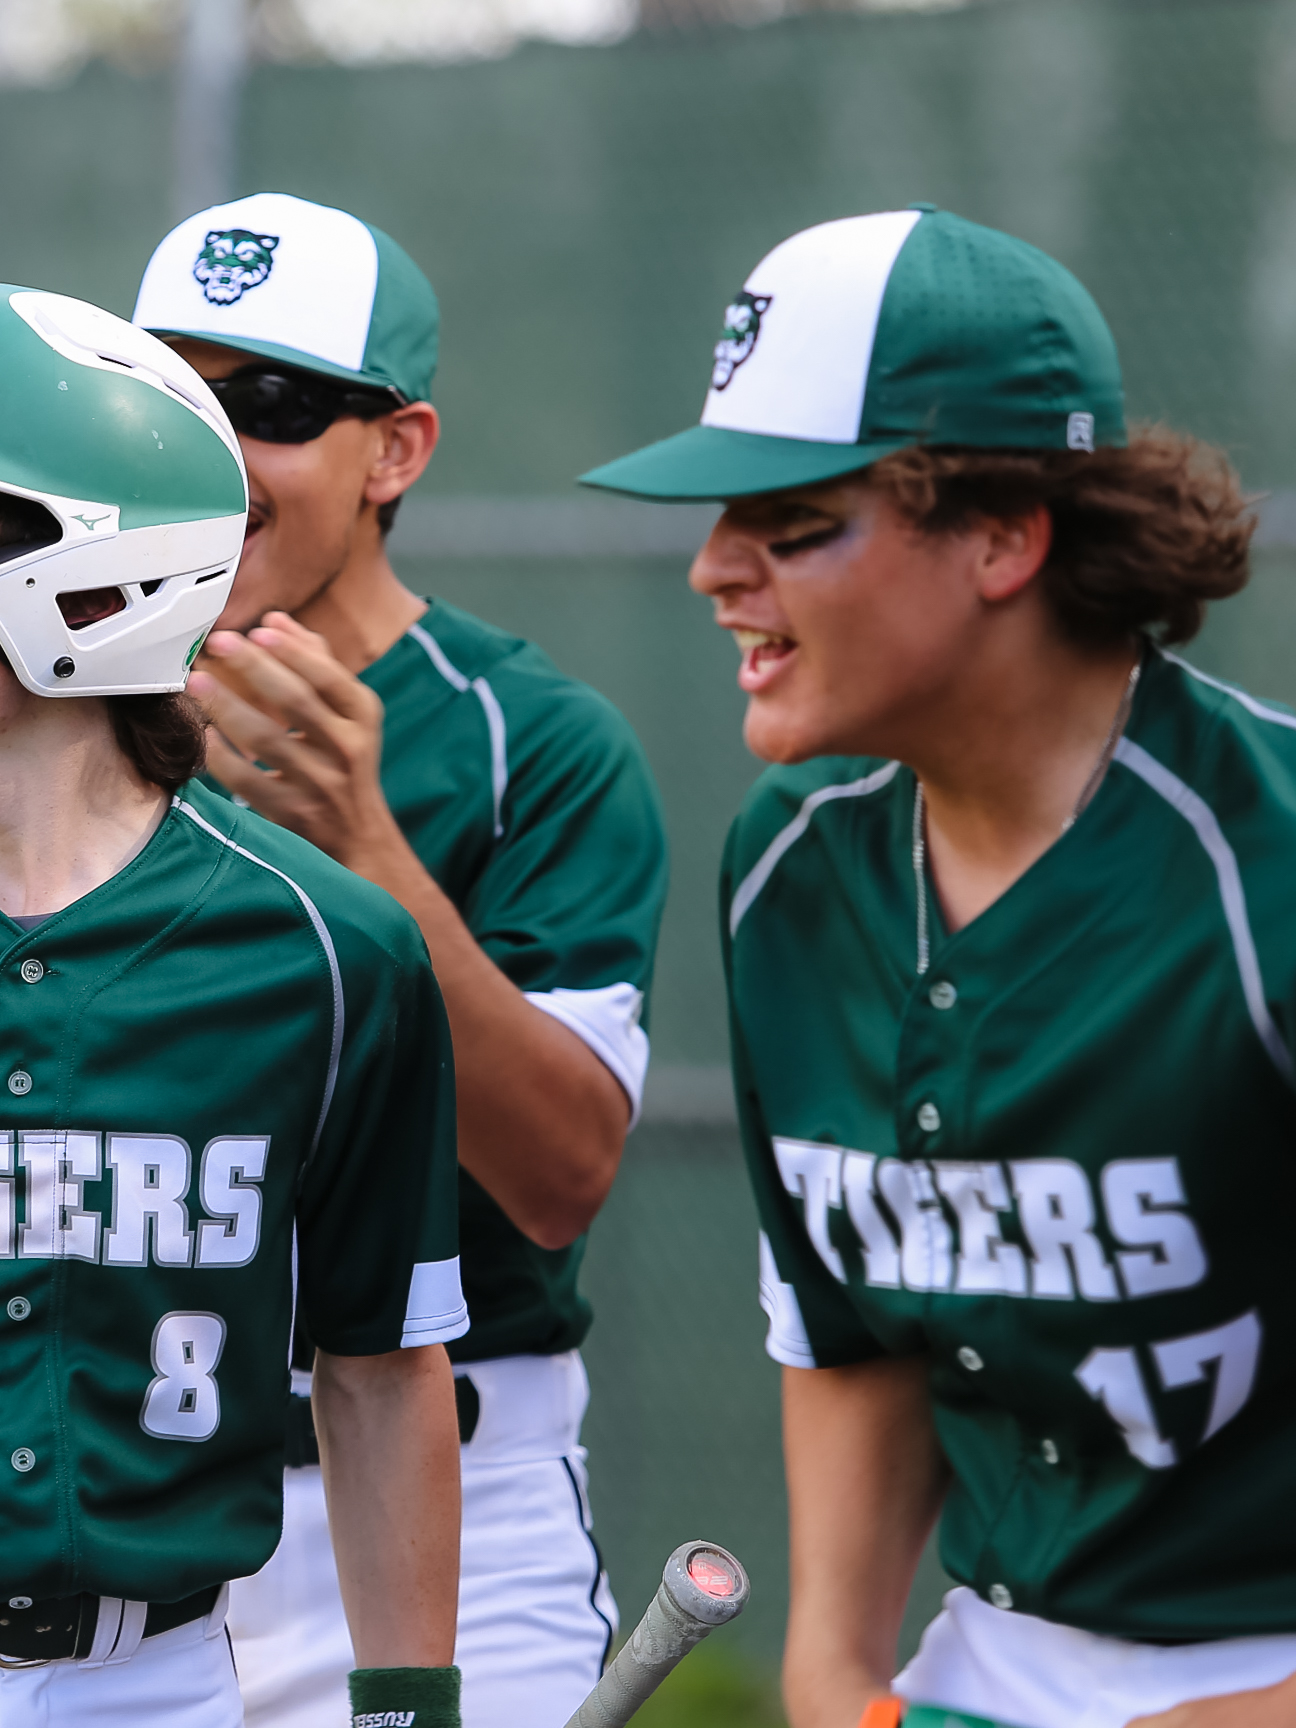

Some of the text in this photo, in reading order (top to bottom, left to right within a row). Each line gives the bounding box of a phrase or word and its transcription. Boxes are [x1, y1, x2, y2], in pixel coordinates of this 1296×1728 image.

[771, 1135, 1208, 1302] TIGERS
[139, 1310, 227, 1442] 8
[1073, 1306, 1262, 1469] 17
